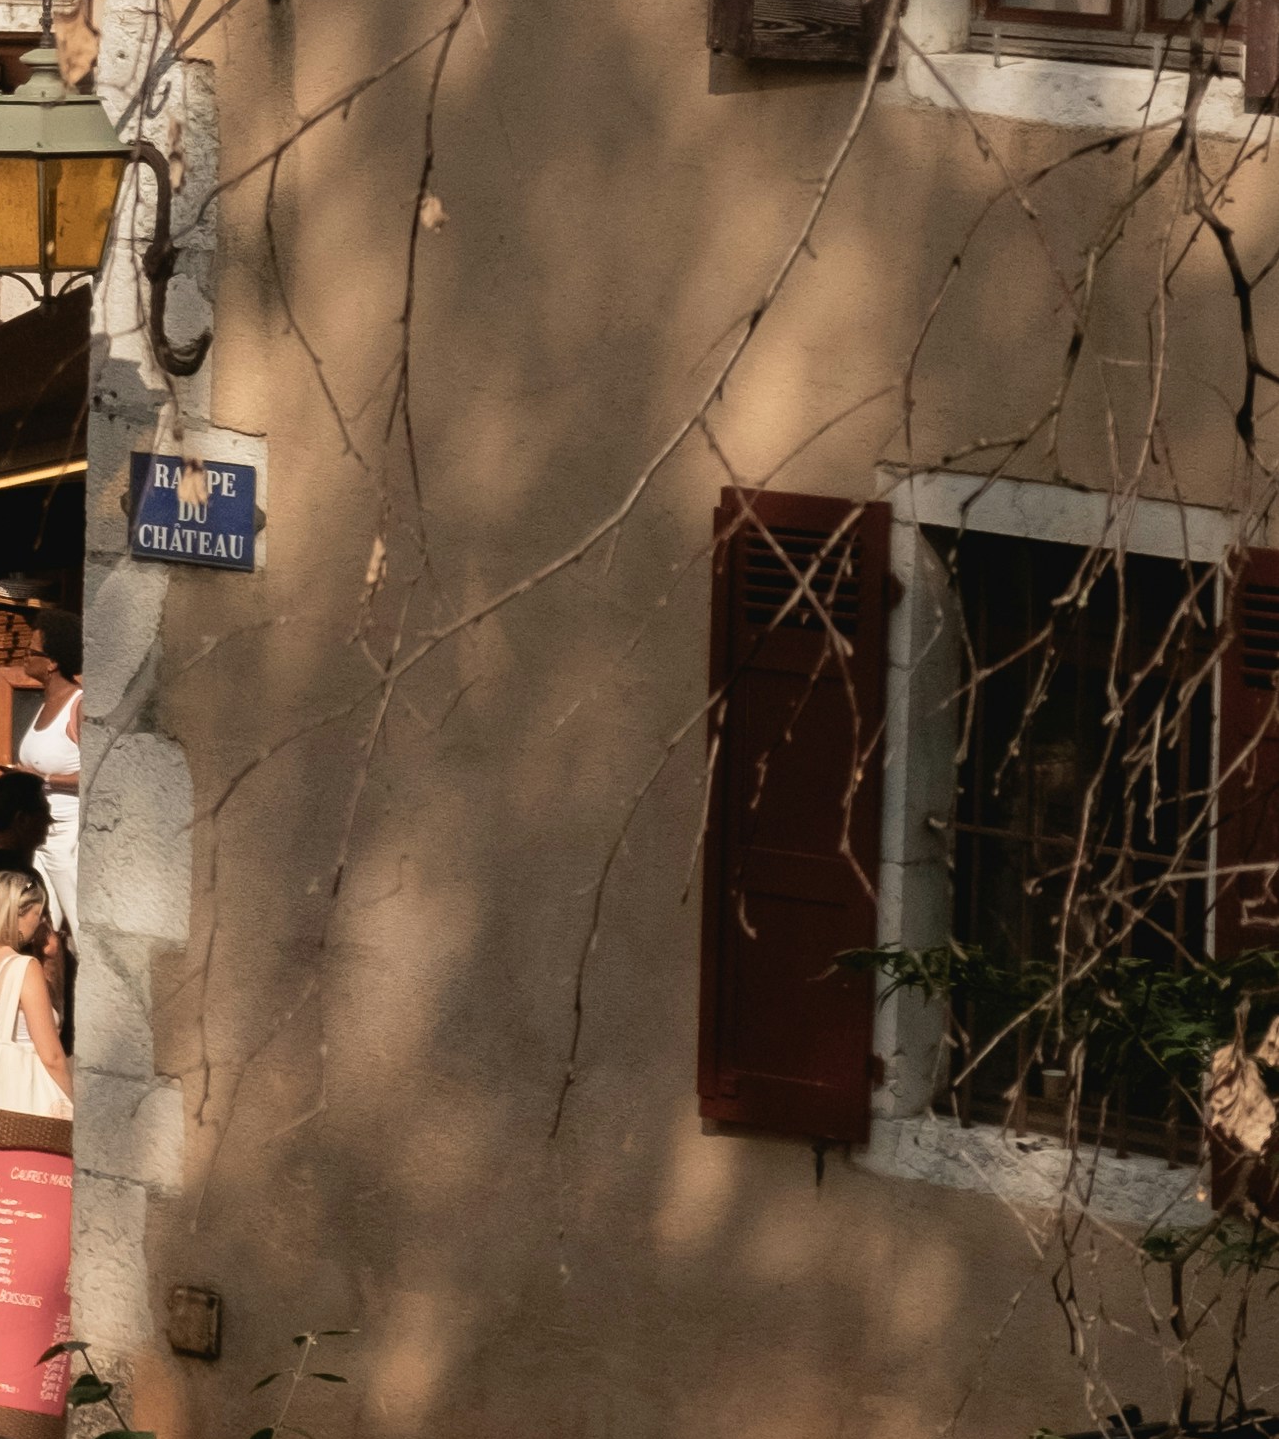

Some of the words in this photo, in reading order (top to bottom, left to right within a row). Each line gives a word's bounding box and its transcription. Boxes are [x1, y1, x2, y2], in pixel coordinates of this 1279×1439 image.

[153, 463, 236, 497] RAPE
[178, 500, 208, 524] DU
[138, 523, 244, 560] CHÂTEAU
